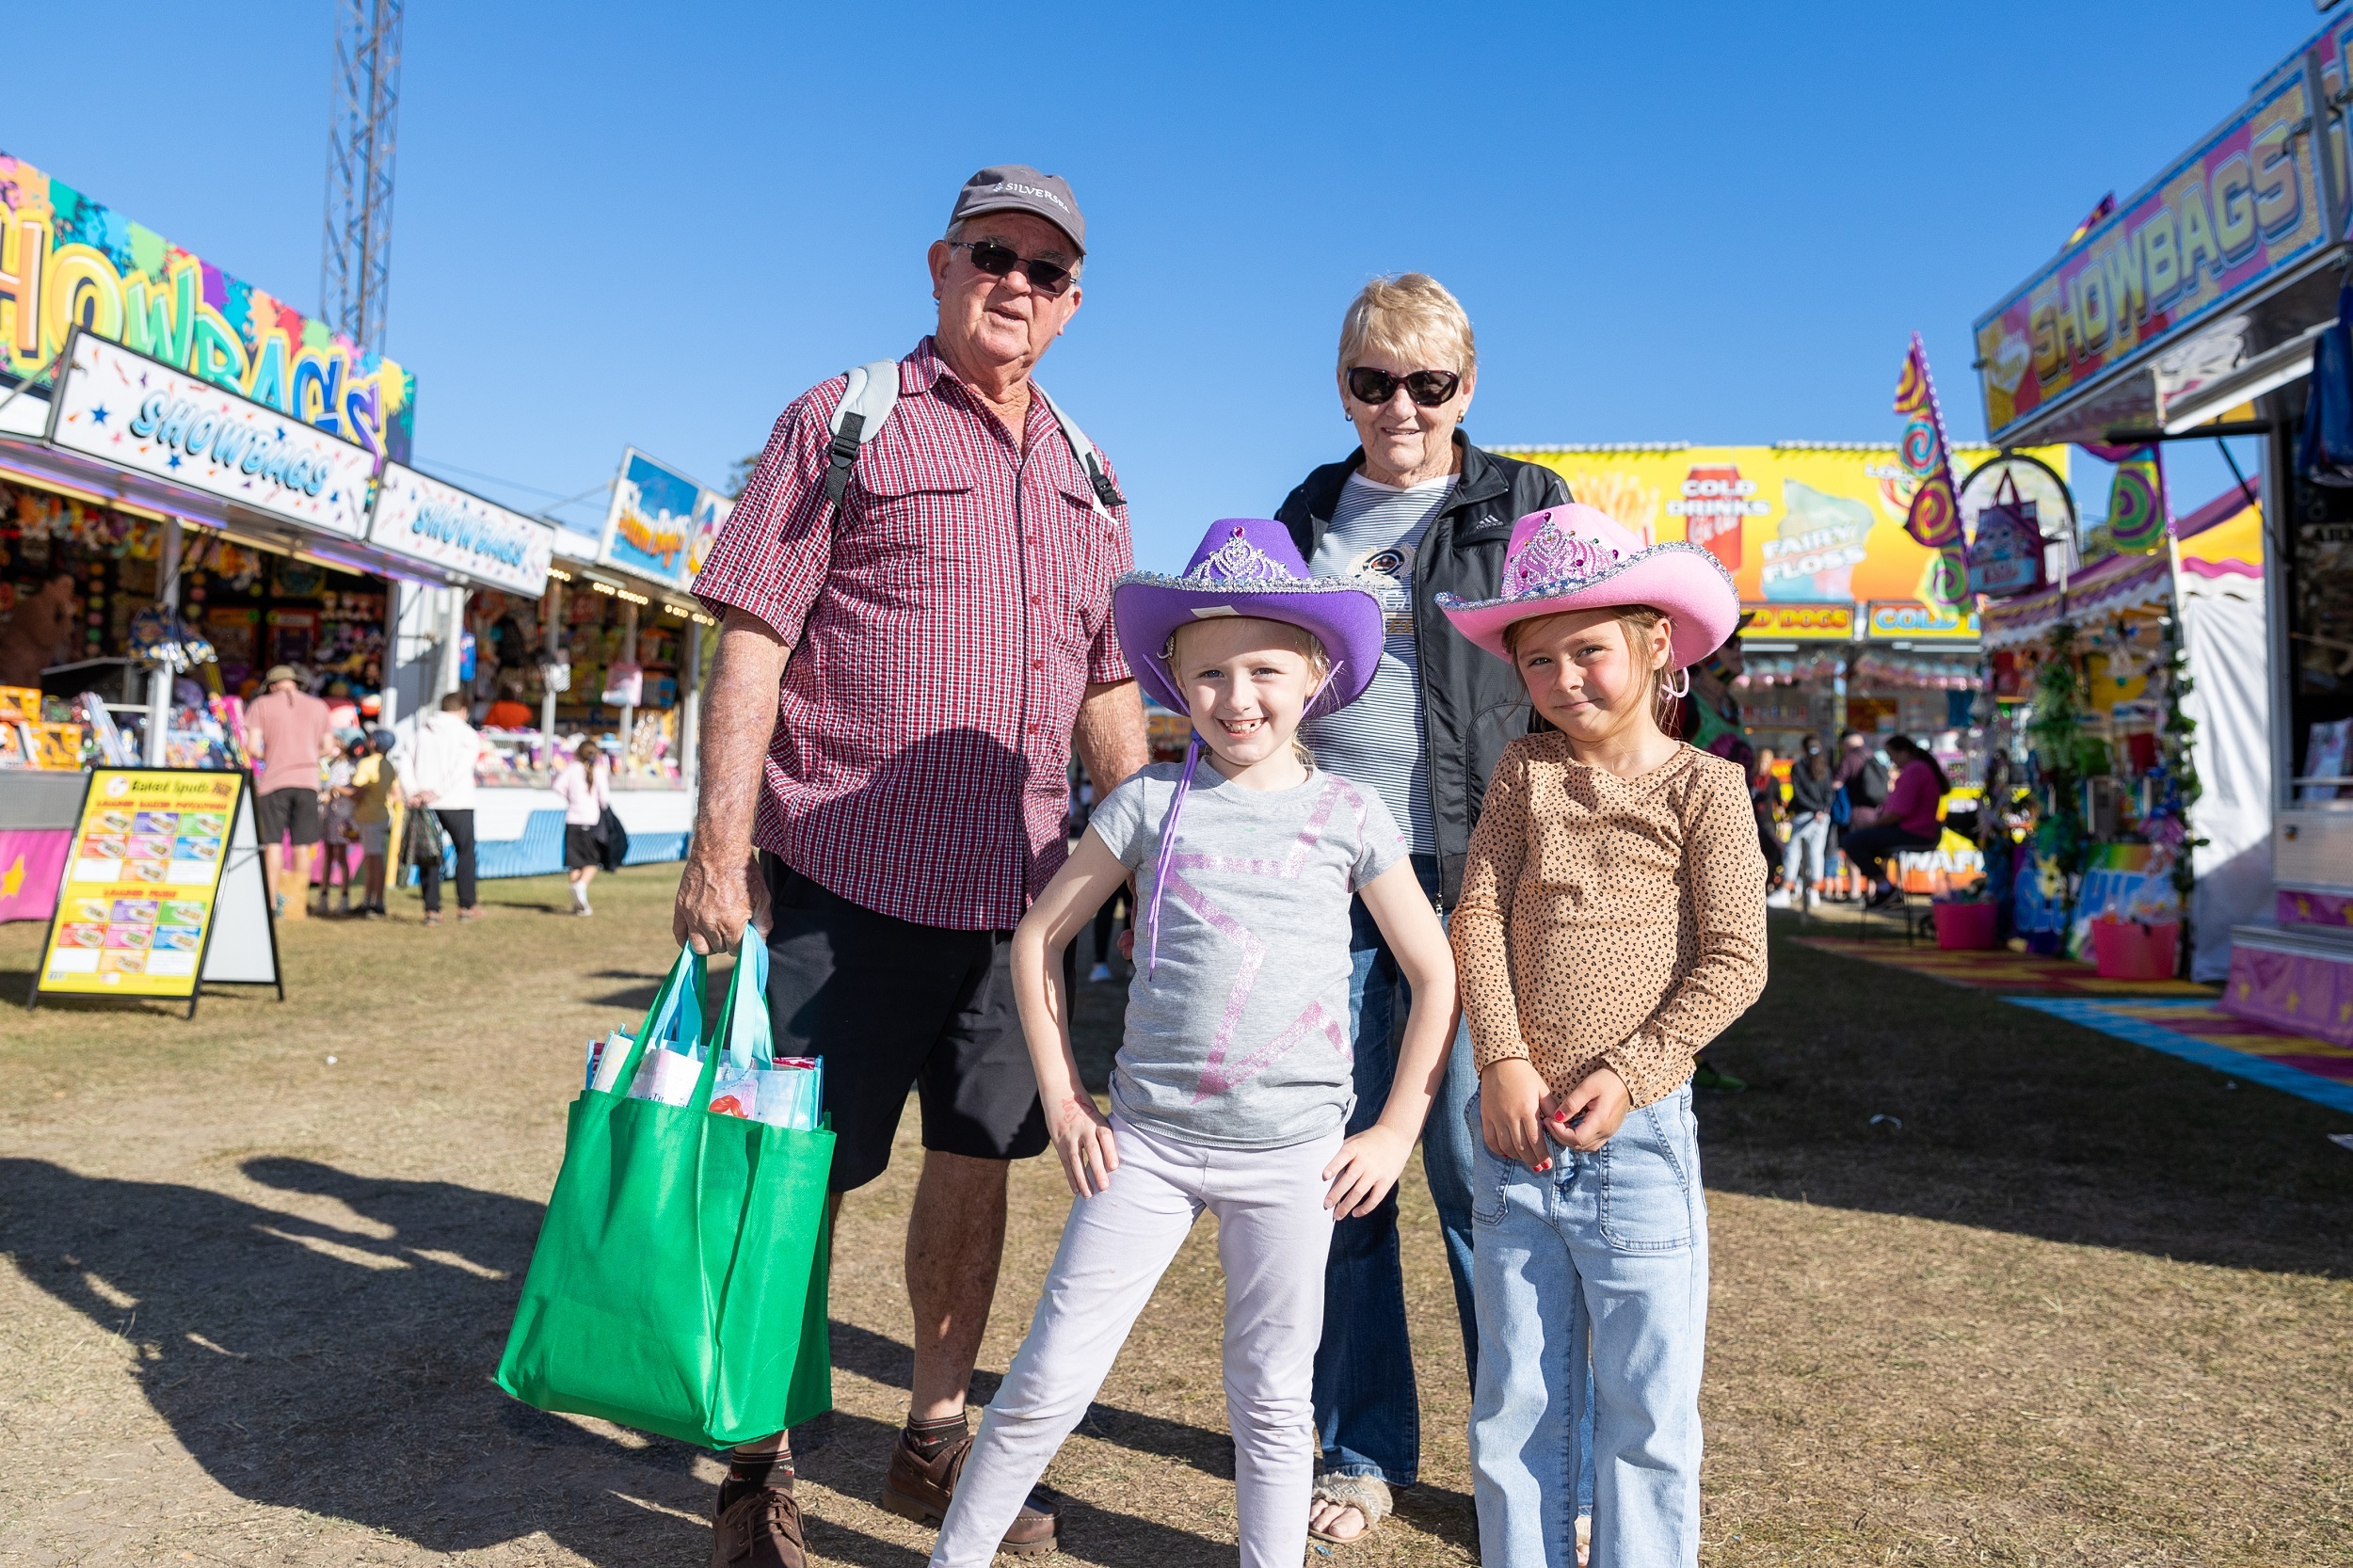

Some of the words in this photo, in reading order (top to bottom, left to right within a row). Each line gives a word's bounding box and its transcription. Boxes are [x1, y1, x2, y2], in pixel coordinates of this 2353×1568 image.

[2027, 120, 2303, 386] SHOWBAGS
[130, 389, 334, 498] SHOWBAGS
[1680, 478, 1758, 497] COLD
[1666, 500, 1771, 517] DRINKS
[411, 497, 533, 567] SHOWBAGS
[1761, 521, 1859, 561] FAIRY
[1761, 544, 1867, 584] FLOSS
[1780, 609, 1848, 629] DOGS
